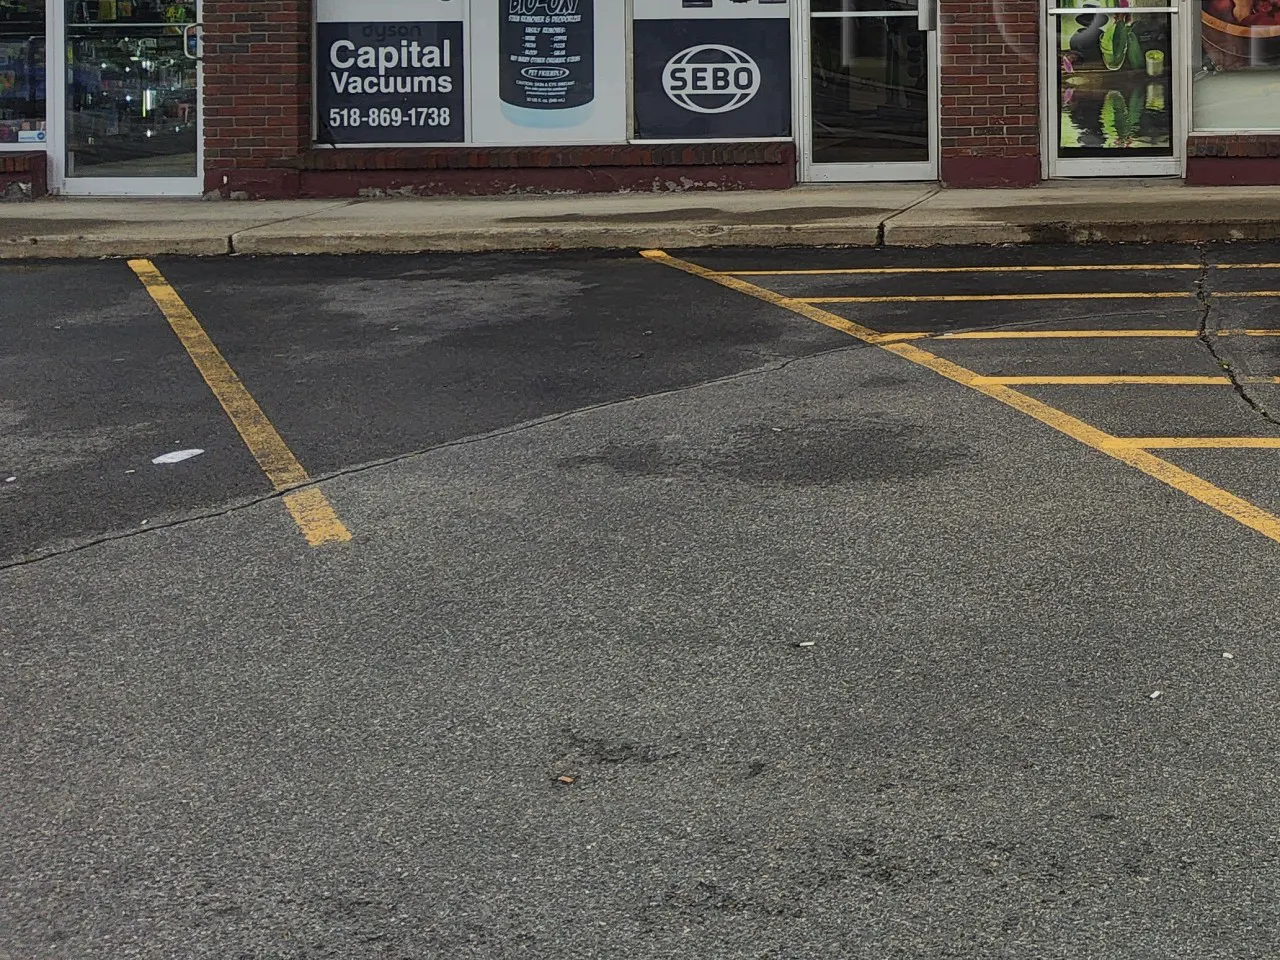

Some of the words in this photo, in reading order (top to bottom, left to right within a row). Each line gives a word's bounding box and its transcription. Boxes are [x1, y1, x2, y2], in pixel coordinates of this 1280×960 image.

[361, 24, 423, 41] dyson
[330, 40, 451, 75] Capital
[330, 72, 453, 93] Vacuums
[670, 67, 752, 91] SEBO
[329, 107, 450, 127] 518-869-1738
